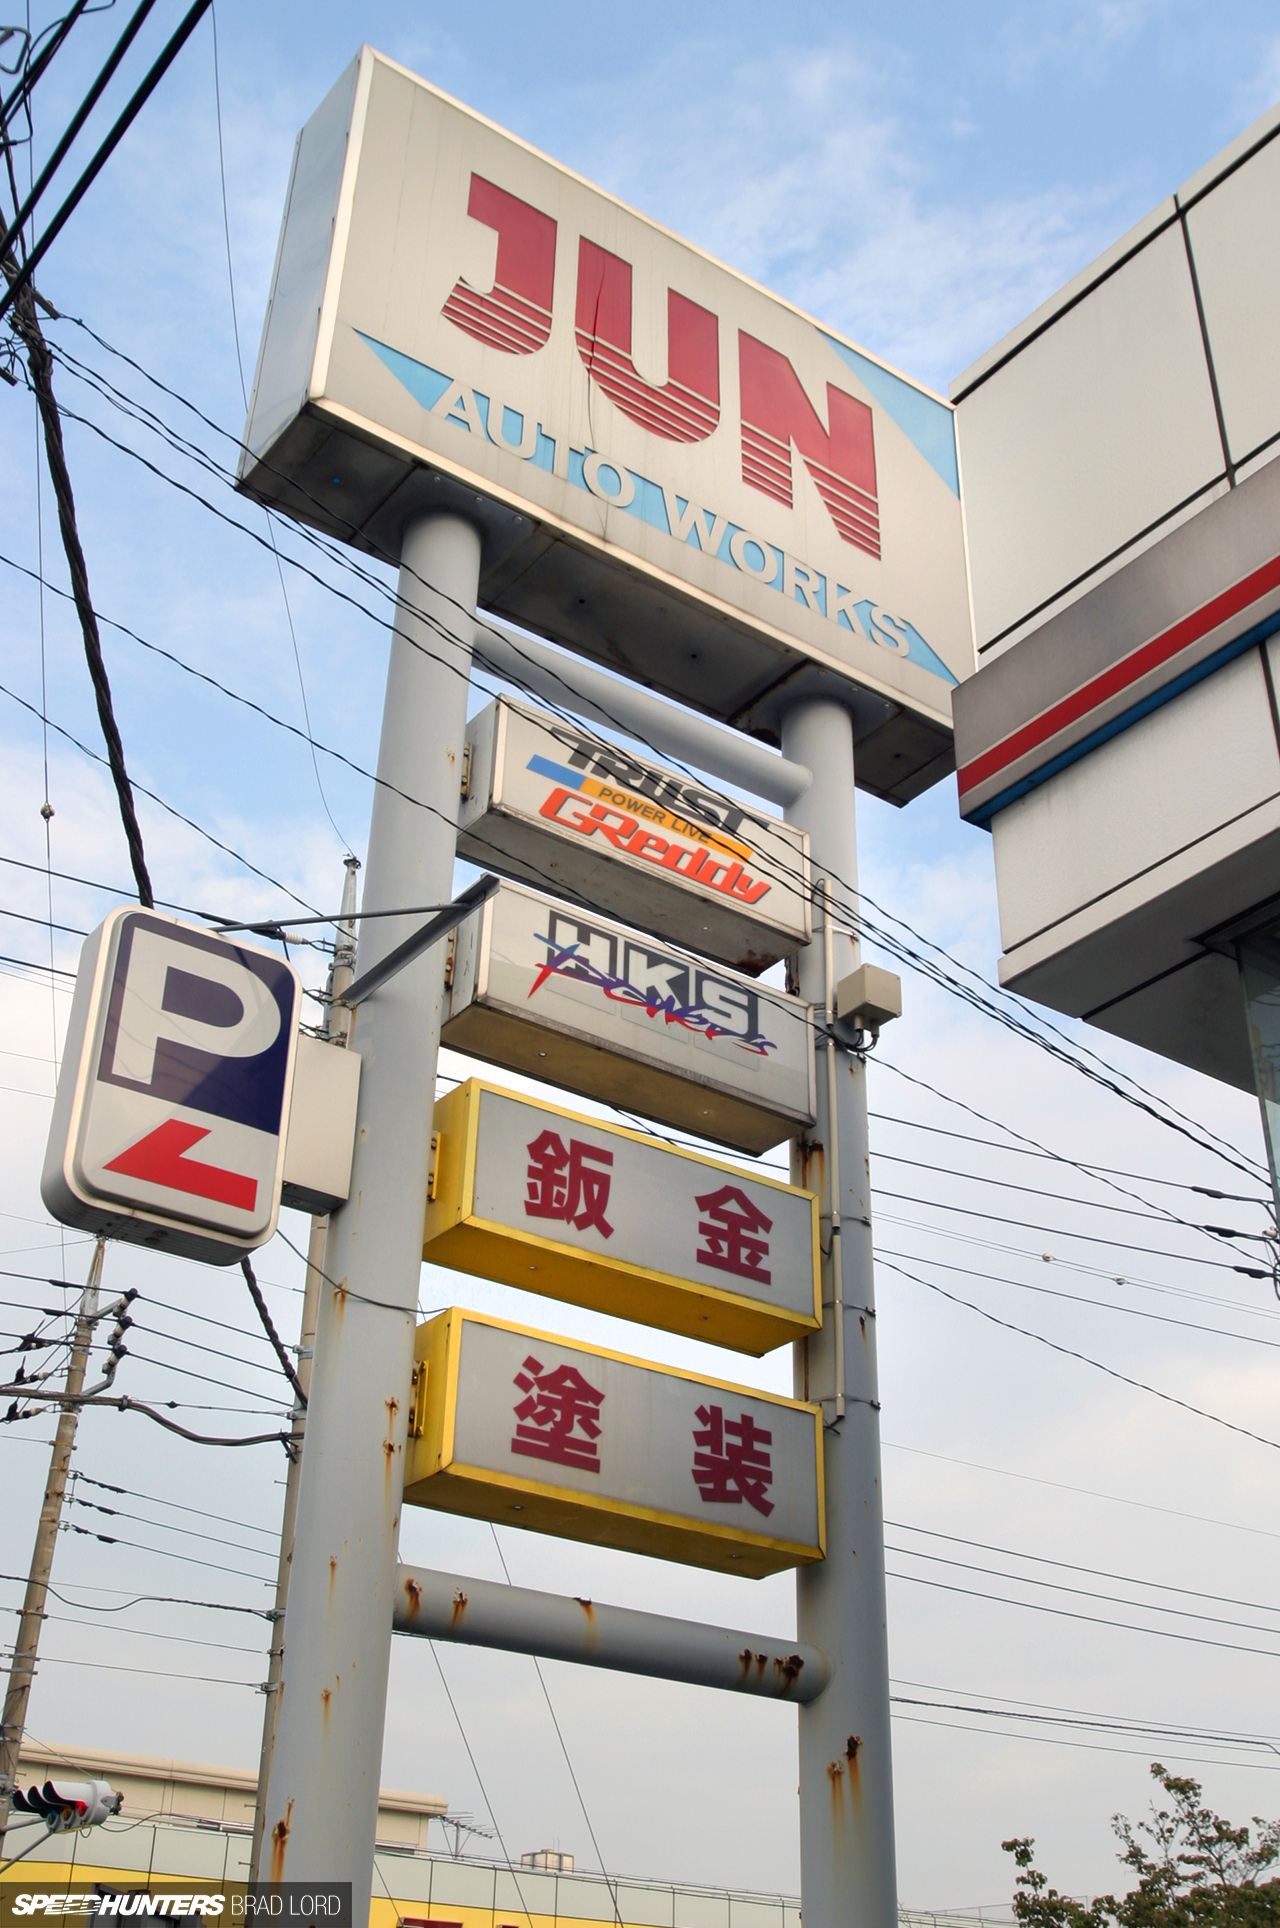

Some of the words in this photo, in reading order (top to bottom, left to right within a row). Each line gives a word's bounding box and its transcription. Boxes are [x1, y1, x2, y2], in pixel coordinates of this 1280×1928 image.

[441, 171, 882, 561] JUN
[431, 379, 636, 508] AUTO
[661, 486, 911, 657] WORKS
[550, 726, 770, 836] TRUST
[598, 787, 666, 824] POWER
[671, 818, 712, 844] LIVE
[111, 926, 281, 1086] P
[547, 910, 759, 1045] HKS
